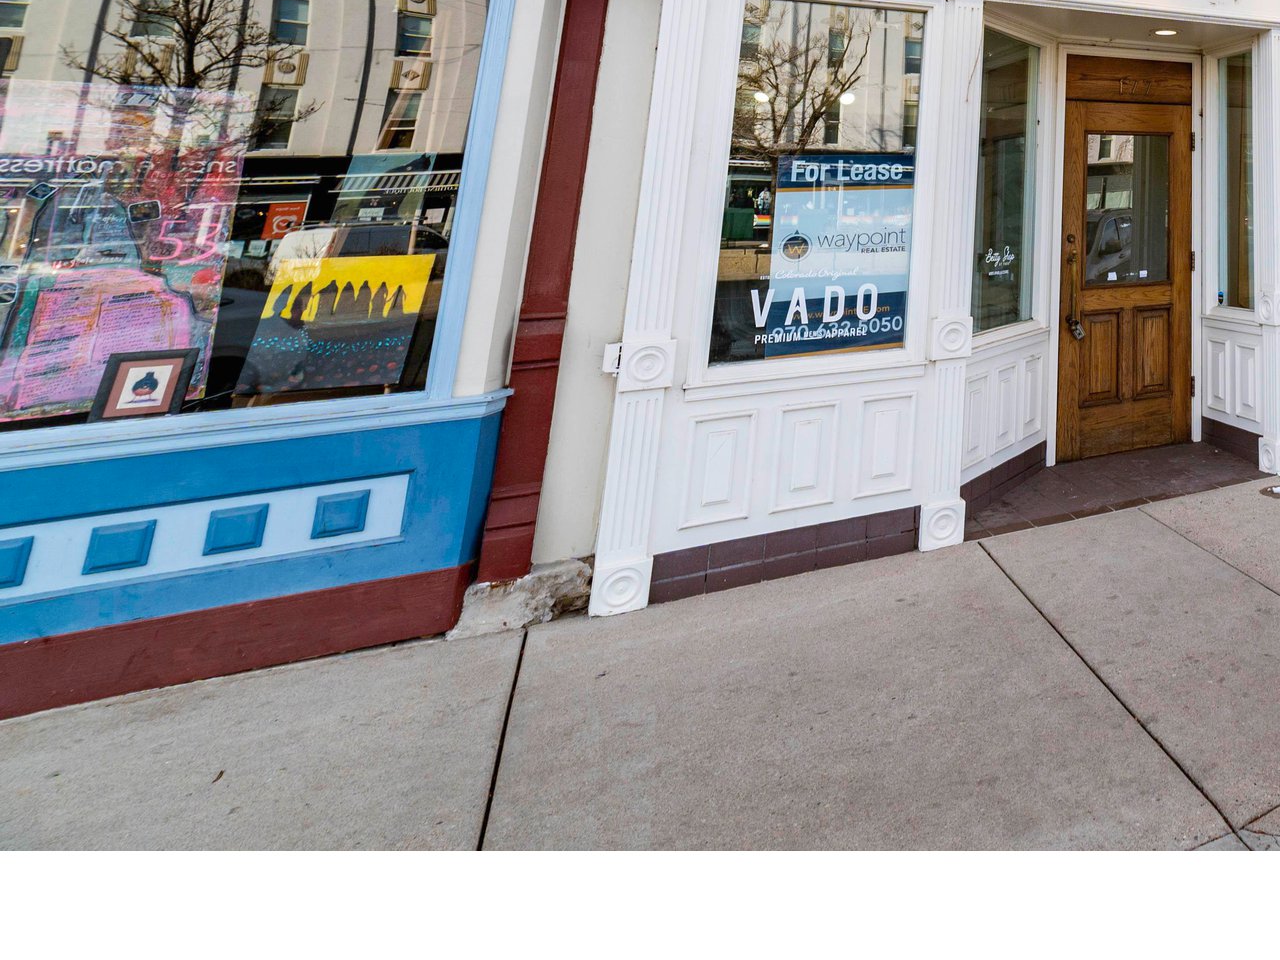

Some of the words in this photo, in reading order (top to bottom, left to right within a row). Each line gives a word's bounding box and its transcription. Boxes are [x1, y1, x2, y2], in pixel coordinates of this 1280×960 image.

[790, 160, 830, 182] For
[837, 159, 903, 181] Lease
[817, 227, 907, 252] waypoint
[774, 269, 818, 280] Colorado
[818, 266, 859, 281] Original
[750, 282, 878, 328] VADO
[754, 331, 800, 345] PREMIUM
[825, 326, 867, 339] APPAREL
